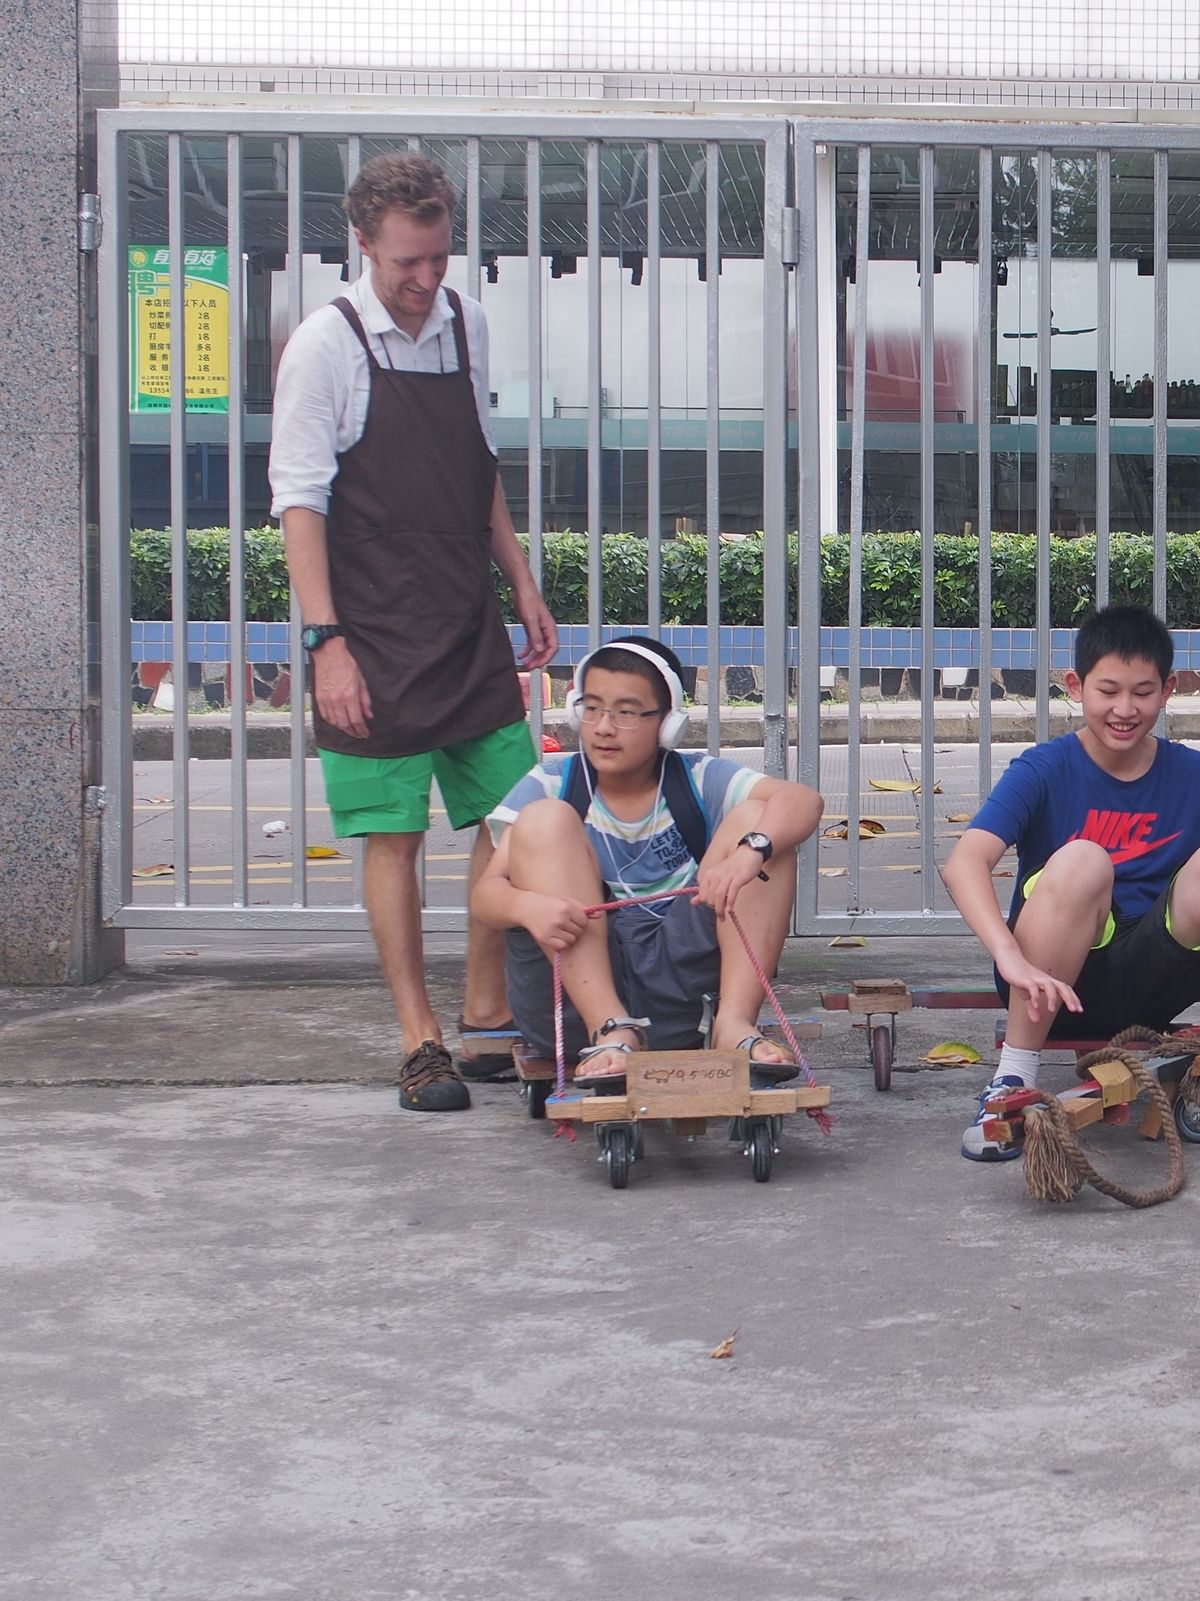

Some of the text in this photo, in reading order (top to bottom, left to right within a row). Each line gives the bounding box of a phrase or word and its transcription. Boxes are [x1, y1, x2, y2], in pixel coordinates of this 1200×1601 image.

[144, 299, 217, 308] 本店招以下人员
[1080, 808, 1158, 849] NIKE
